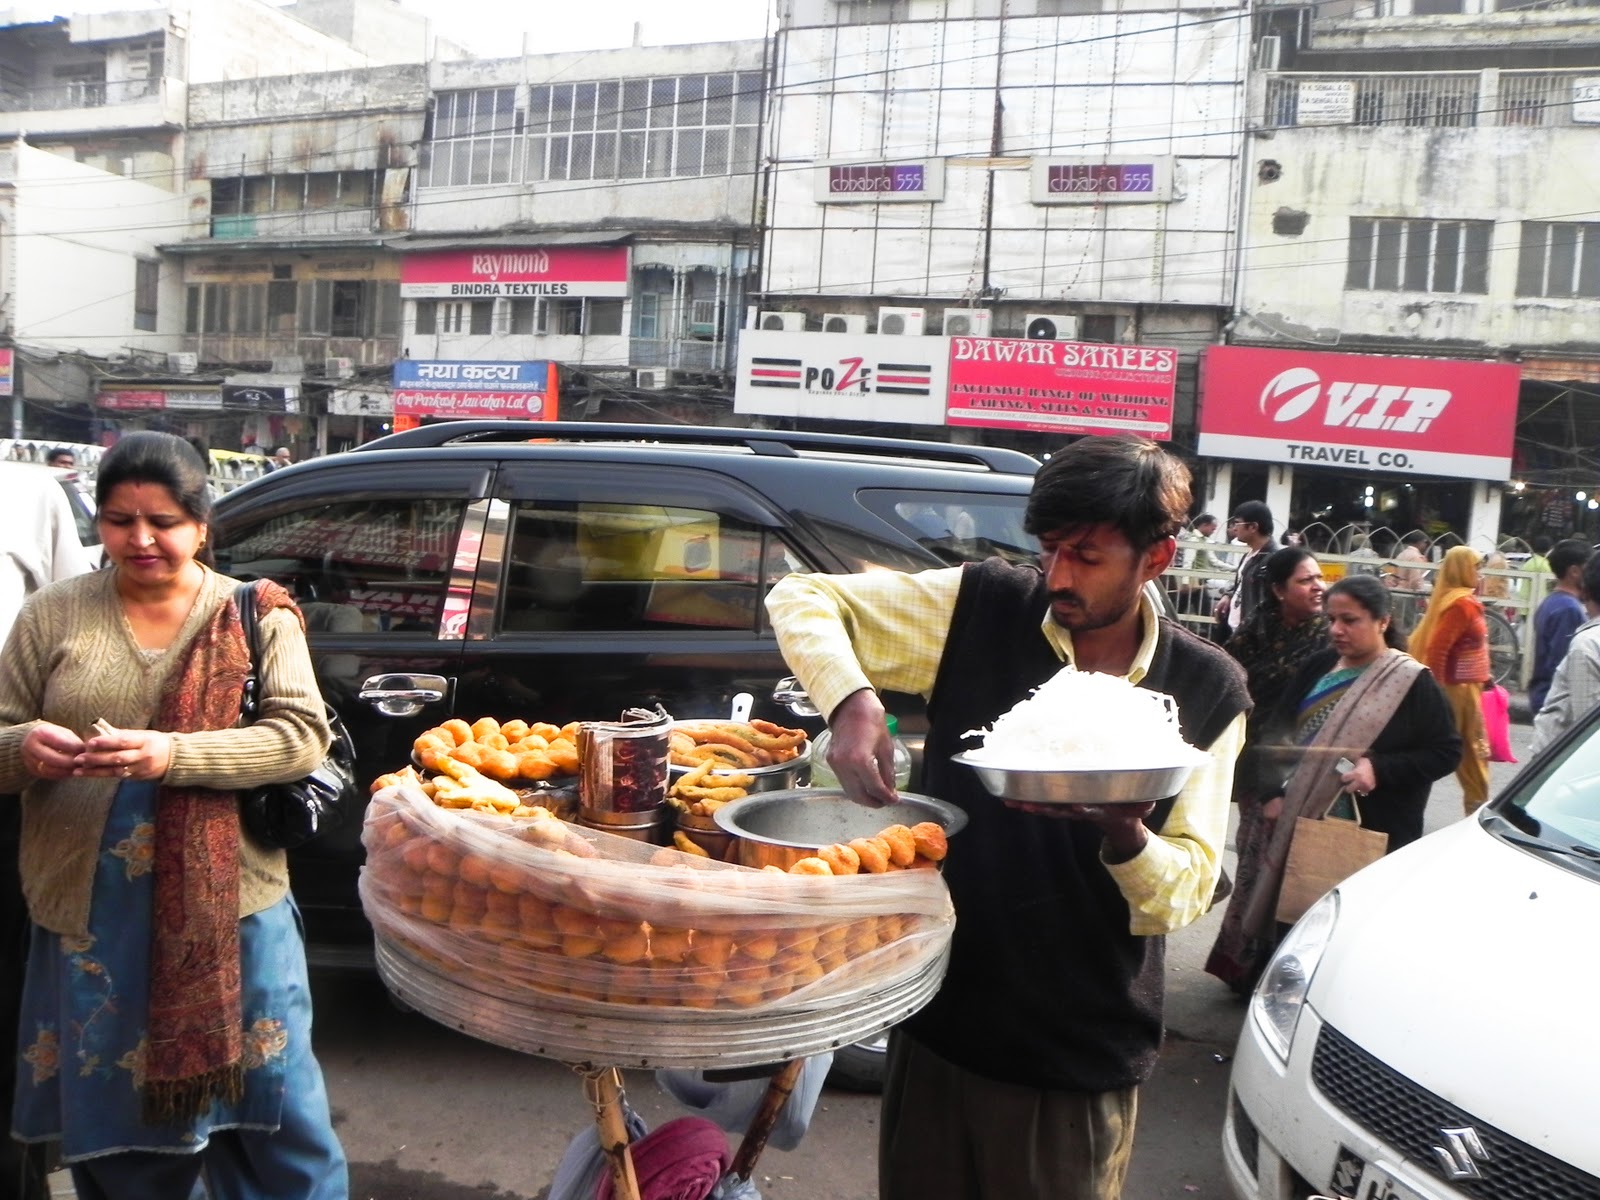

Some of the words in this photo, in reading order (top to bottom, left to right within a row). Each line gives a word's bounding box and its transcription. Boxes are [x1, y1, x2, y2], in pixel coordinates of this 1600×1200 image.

[831, 166, 892, 191] chhabra
[897, 173, 922, 190] 555
[1050, 165, 1118, 191] chhabra
[1123, 173, 1151, 191] 555
[472, 250, 549, 280] Raymond
[451, 283, 501, 295] BINDRA
[505, 283, 569, 295] TEXTILES
[954, 338, 1057, 365] DAWAR
[1063, 344, 1173, 372] SAREES
[418, 363, 460, 379] नया
[461, 364, 521, 381] कटरा
[805, 357, 872, 393] POZE
[414, 392, 458, 410] Parkash
[458, 393, 506, 412] Jawahar
[506, 394, 527, 409] Lal
[953, 384, 1025, 396] EXCLUSIVE
[1029, 388, 1073, 400] RANGE
[1078, 391, 1095, 401] OF
[1101, 392, 1169, 406] WEDDING
[1082, 406, 1091, 415] &
[1096, 407, 1149, 418] SAREES
[1287, 444, 1370, 465] TRAVEL
[1378, 452, 1414, 469] CO.
